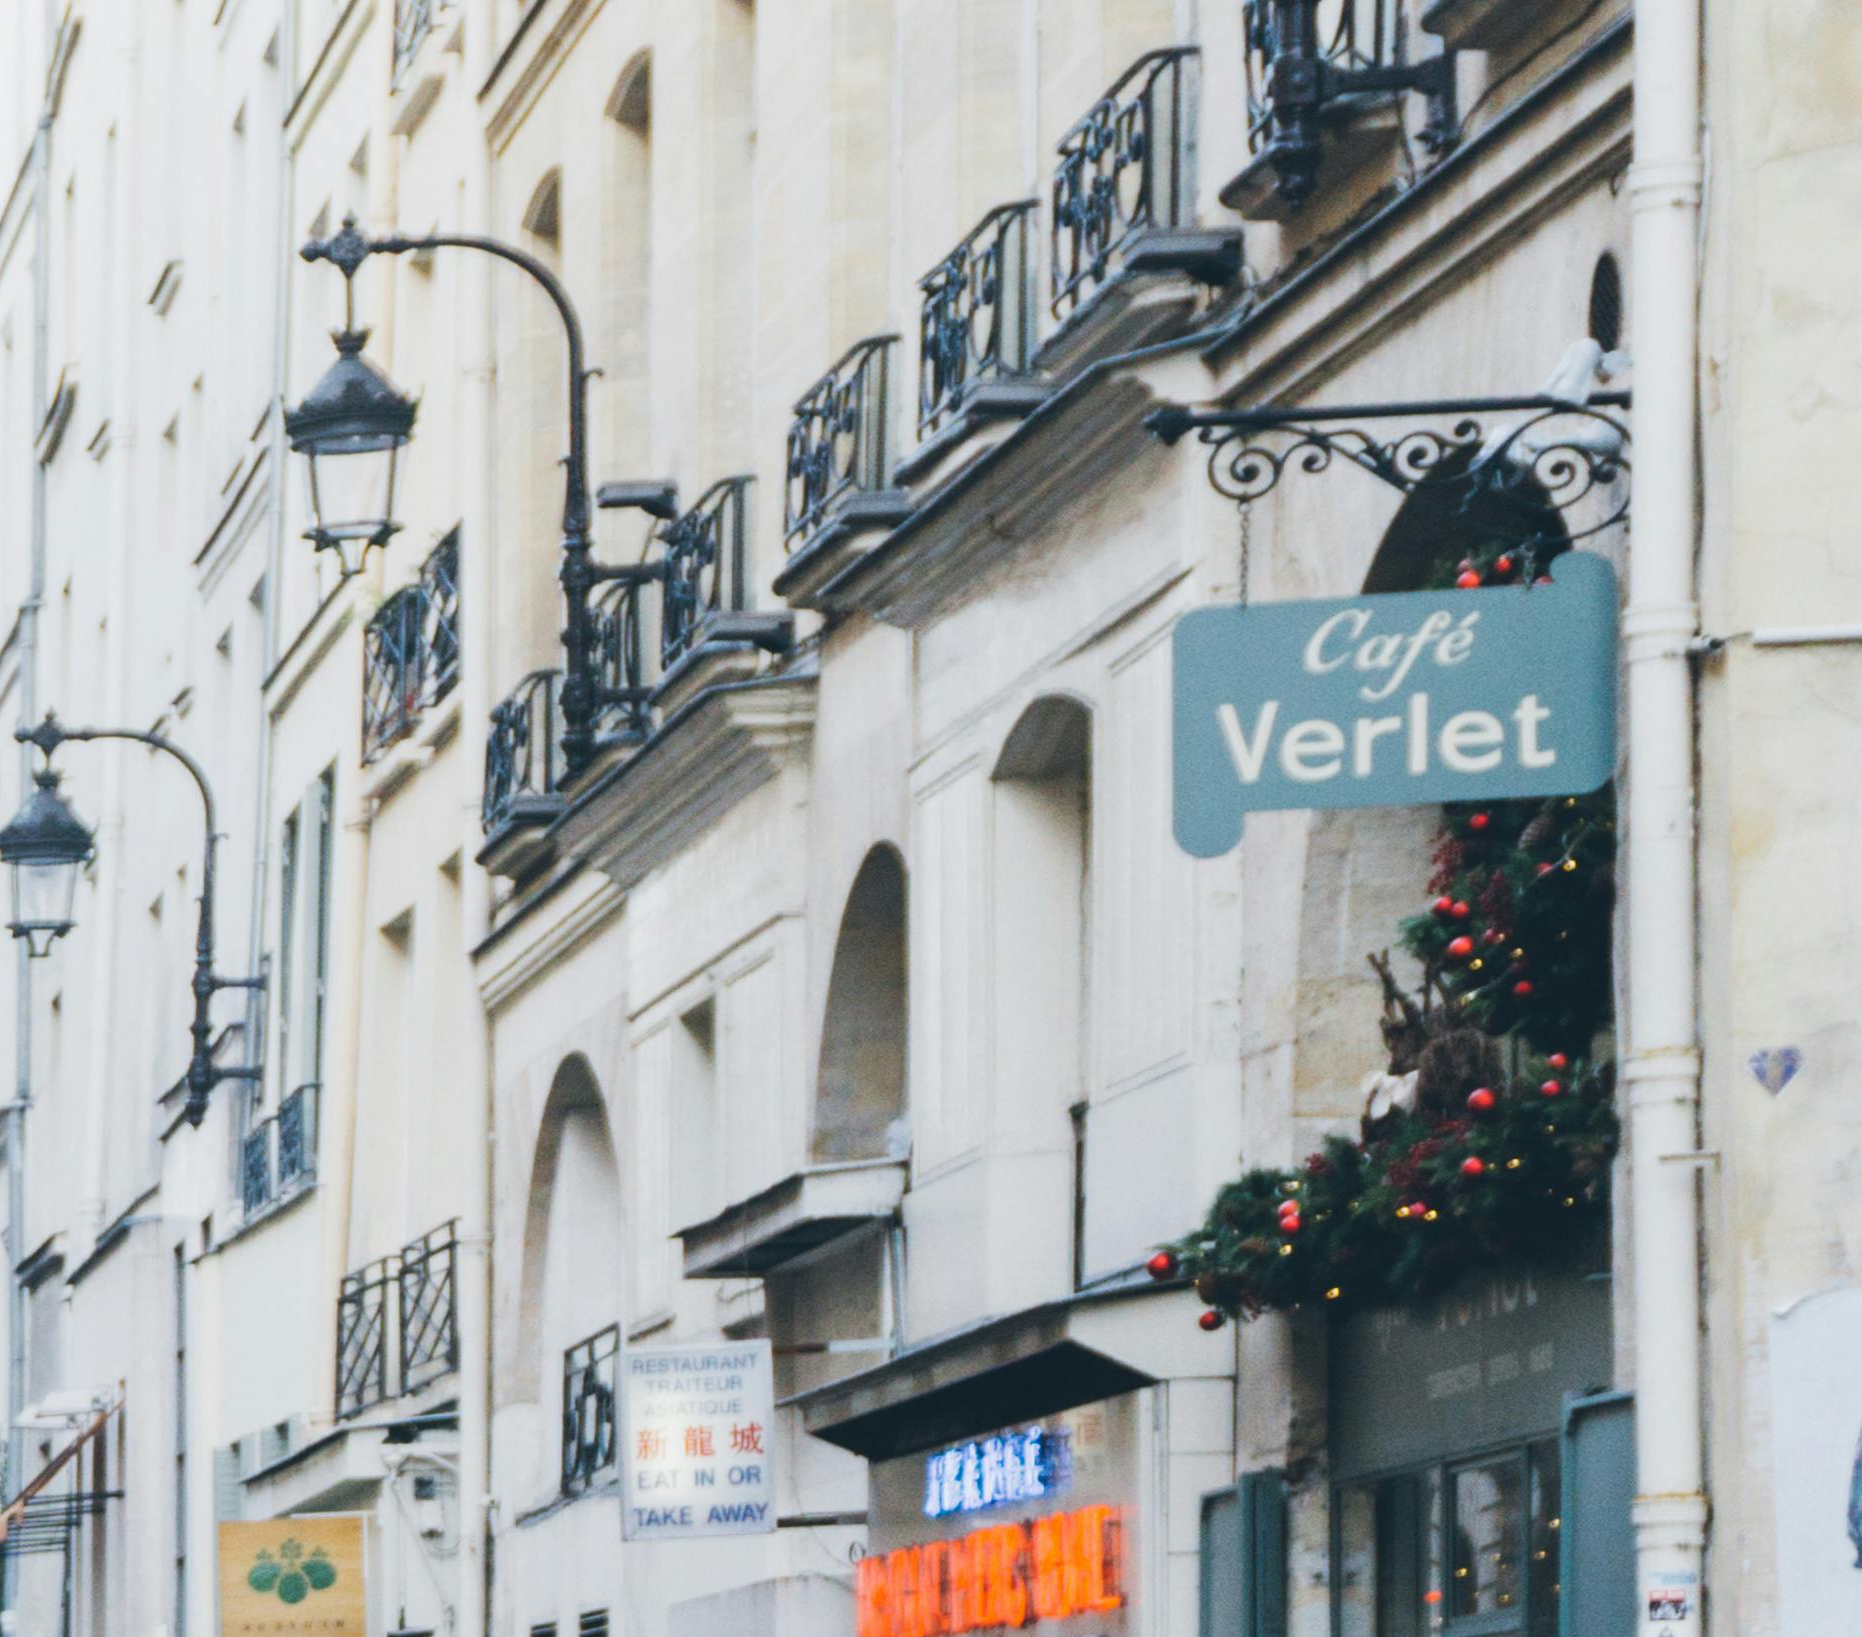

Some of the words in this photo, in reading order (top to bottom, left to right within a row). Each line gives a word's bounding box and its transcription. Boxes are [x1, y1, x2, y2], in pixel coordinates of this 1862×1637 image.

[1302, 607, 1482, 700] Café
[1217, 690, 1558, 786] Verlet
[631, 1353, 760, 1375] RESTAURANT
[645, 1375, 743, 1394] TRAITEUR
[643, 1398, 744, 1418] ASIATIQUE
[636, 1421, 764, 1461] 新龍城
[637, 1471, 682, 1490] EAT
[694, 1469, 716, 1487] IN
[728, 1466, 761, 1486] OR
[633, 1505, 692, 1528] TAKE
[707, 1502, 769, 1523] AWAY
